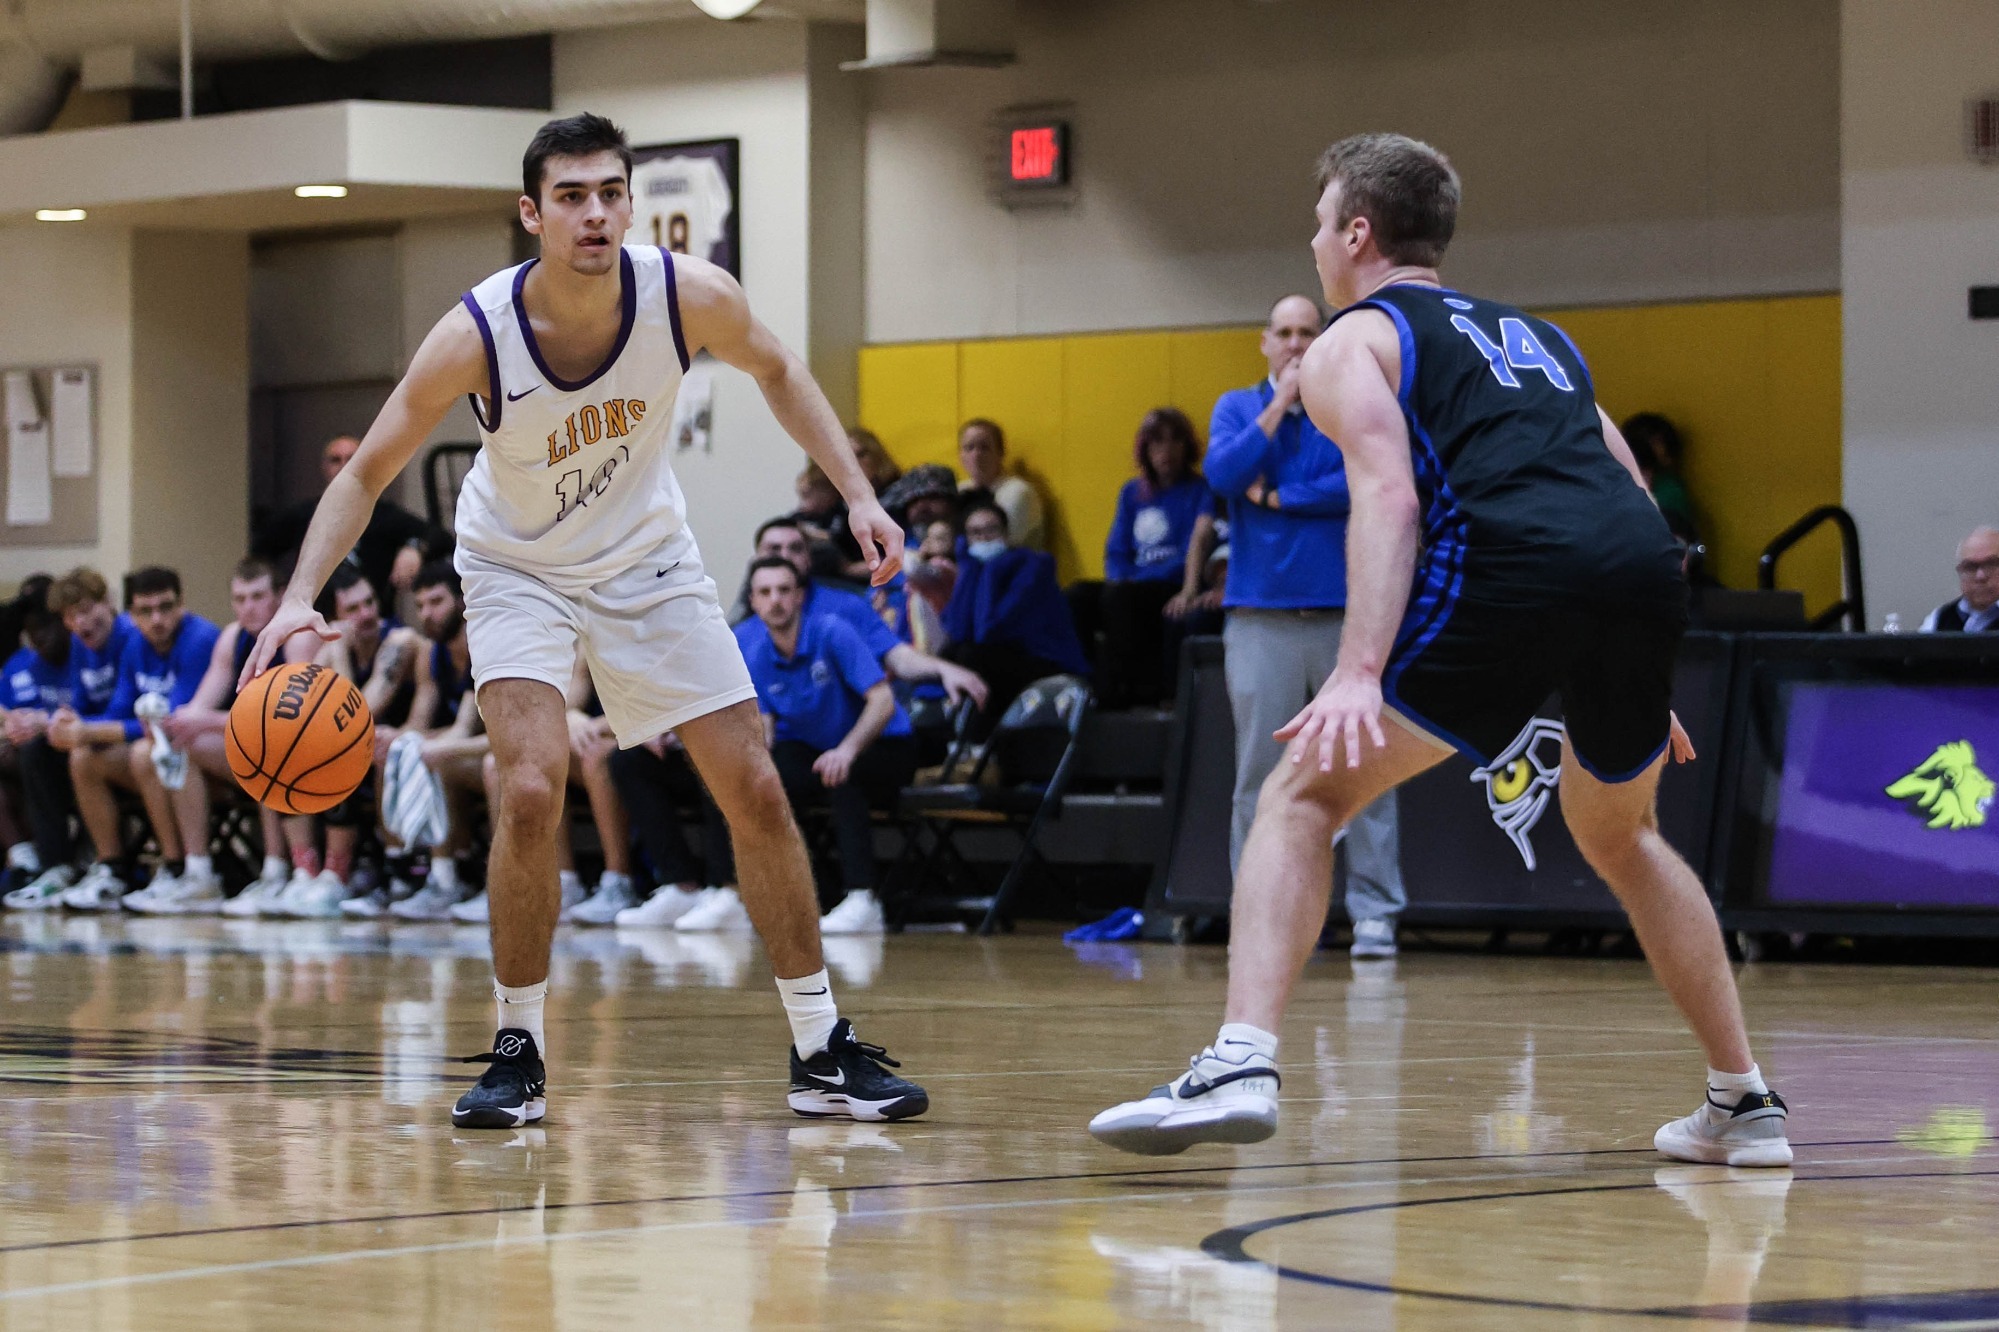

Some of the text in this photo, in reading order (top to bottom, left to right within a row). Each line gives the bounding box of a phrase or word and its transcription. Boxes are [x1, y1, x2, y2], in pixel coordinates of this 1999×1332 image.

[1011, 127, 1059, 180] EXIT
[1449, 314, 1575, 391] 14
[547, 398, 646, 467] LIONS
[273, 664, 324, 720] Wilso
[1762, 1096, 1774, 1107] 12
